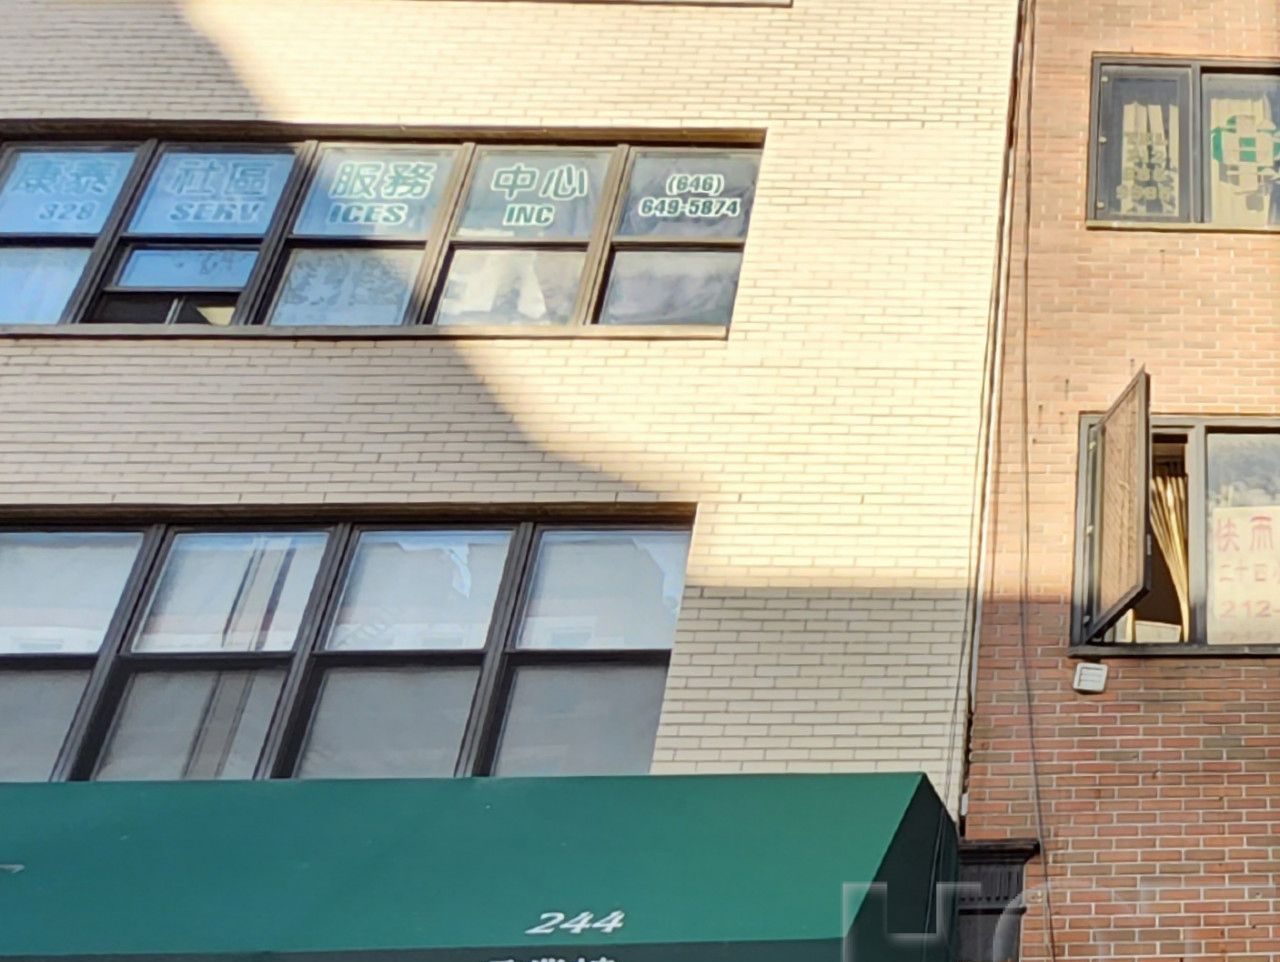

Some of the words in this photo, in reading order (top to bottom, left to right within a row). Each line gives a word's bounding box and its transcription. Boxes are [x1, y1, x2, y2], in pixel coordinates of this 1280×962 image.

[168, 159, 276, 197] 社區
[333, 158, 437, 199] 服務
[491, 162, 588, 199] 中心
[665, 173, 725, 196] (646)
[169, 201, 261, 223] SERV
[327, 203, 408, 226] ICES
[503, 204, 554, 226] INC
[638, 197, 741, 217] 649-5874
[524, 909, 626, 935] 244
